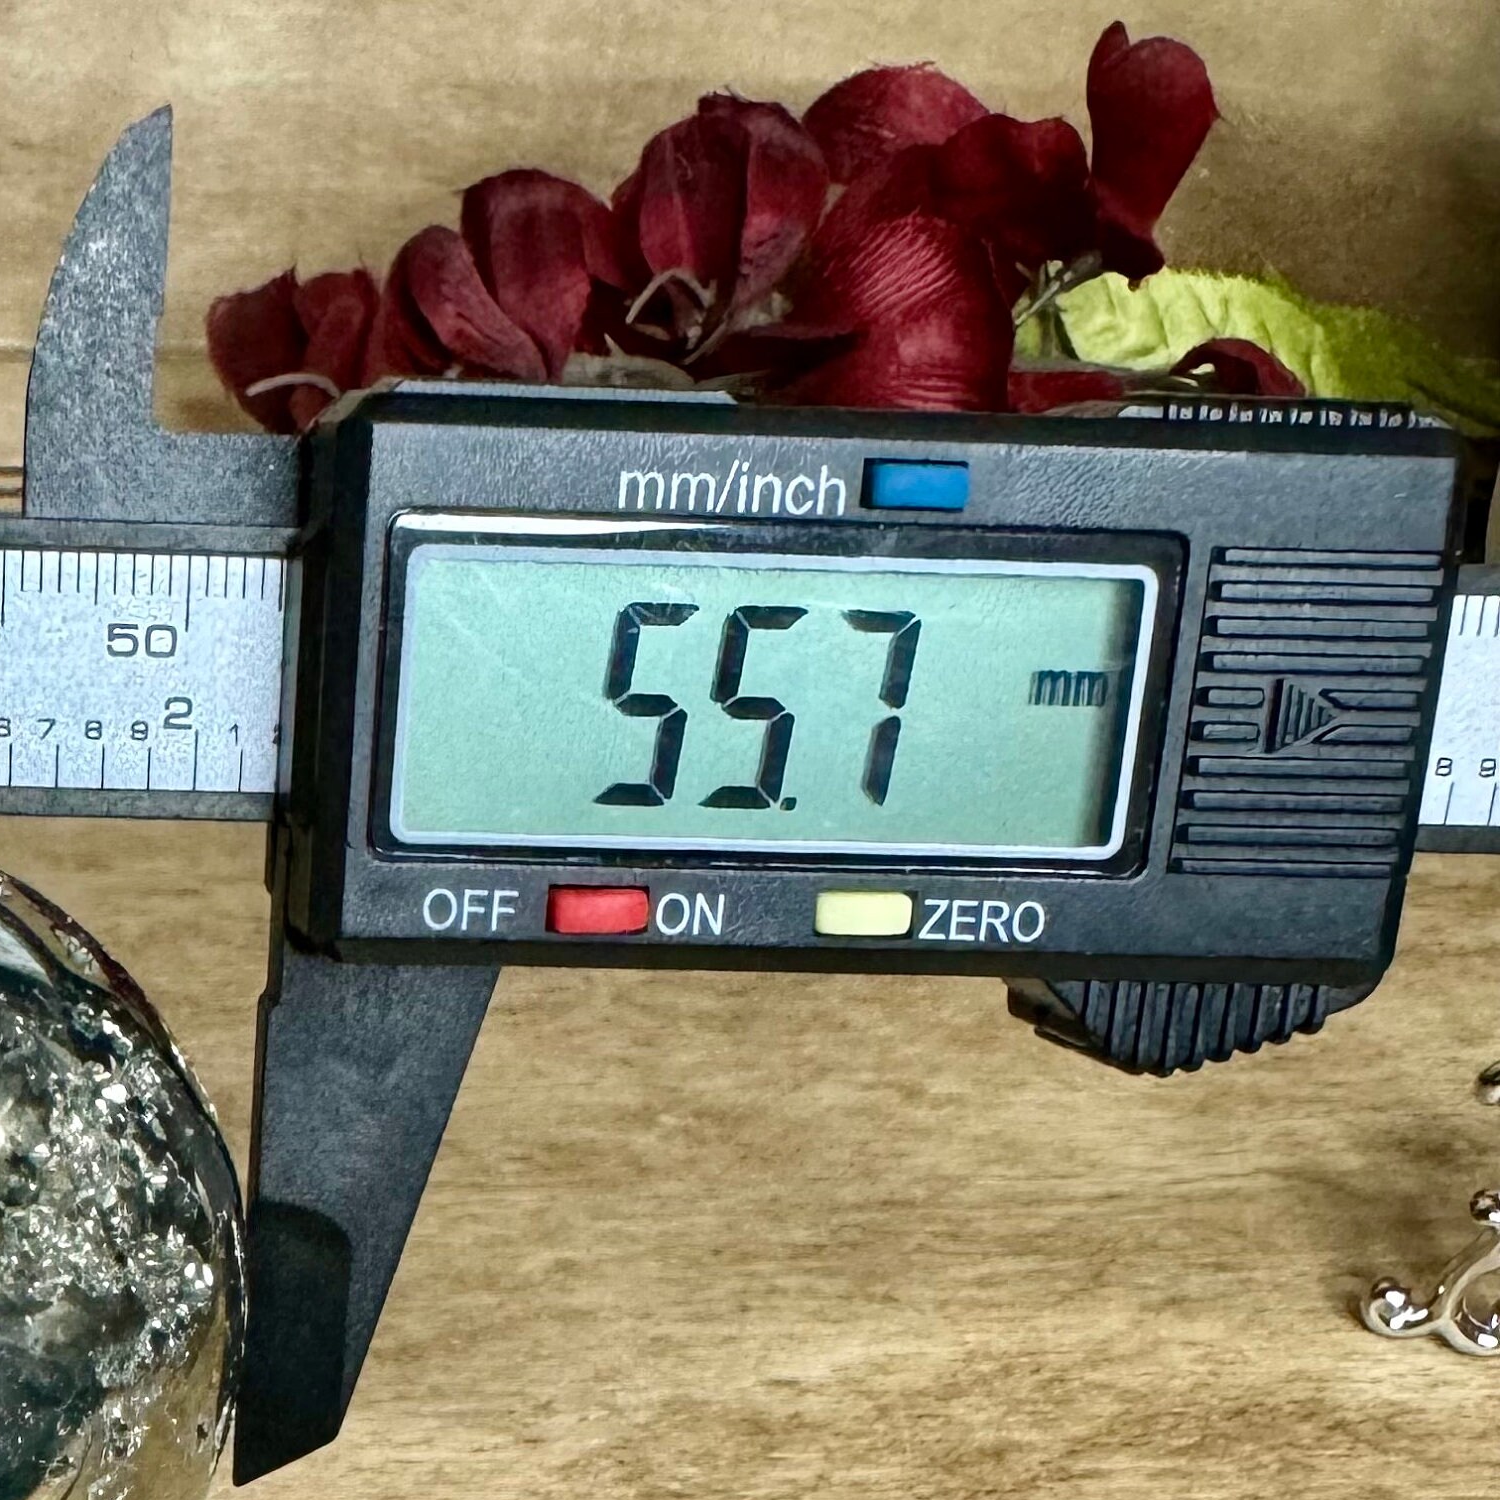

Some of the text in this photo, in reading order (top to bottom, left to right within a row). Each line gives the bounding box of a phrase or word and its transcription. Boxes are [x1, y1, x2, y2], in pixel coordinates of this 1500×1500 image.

[617, 456, 848, 518] mm/inch
[107, 623, 177, 657] 50
[592, 601, 922, 812] 55.7
[1028, 669, 1108, 706] mm
[37, 718, 56, 739] 7
[84, 720, 103, 740] 8
[163, 697, 193, 730] 2
[228, 723, 240, 746] 1
[1435, 757, 1452, 777] 8
[421, 886, 1046, 944] OFF ON ZERO
